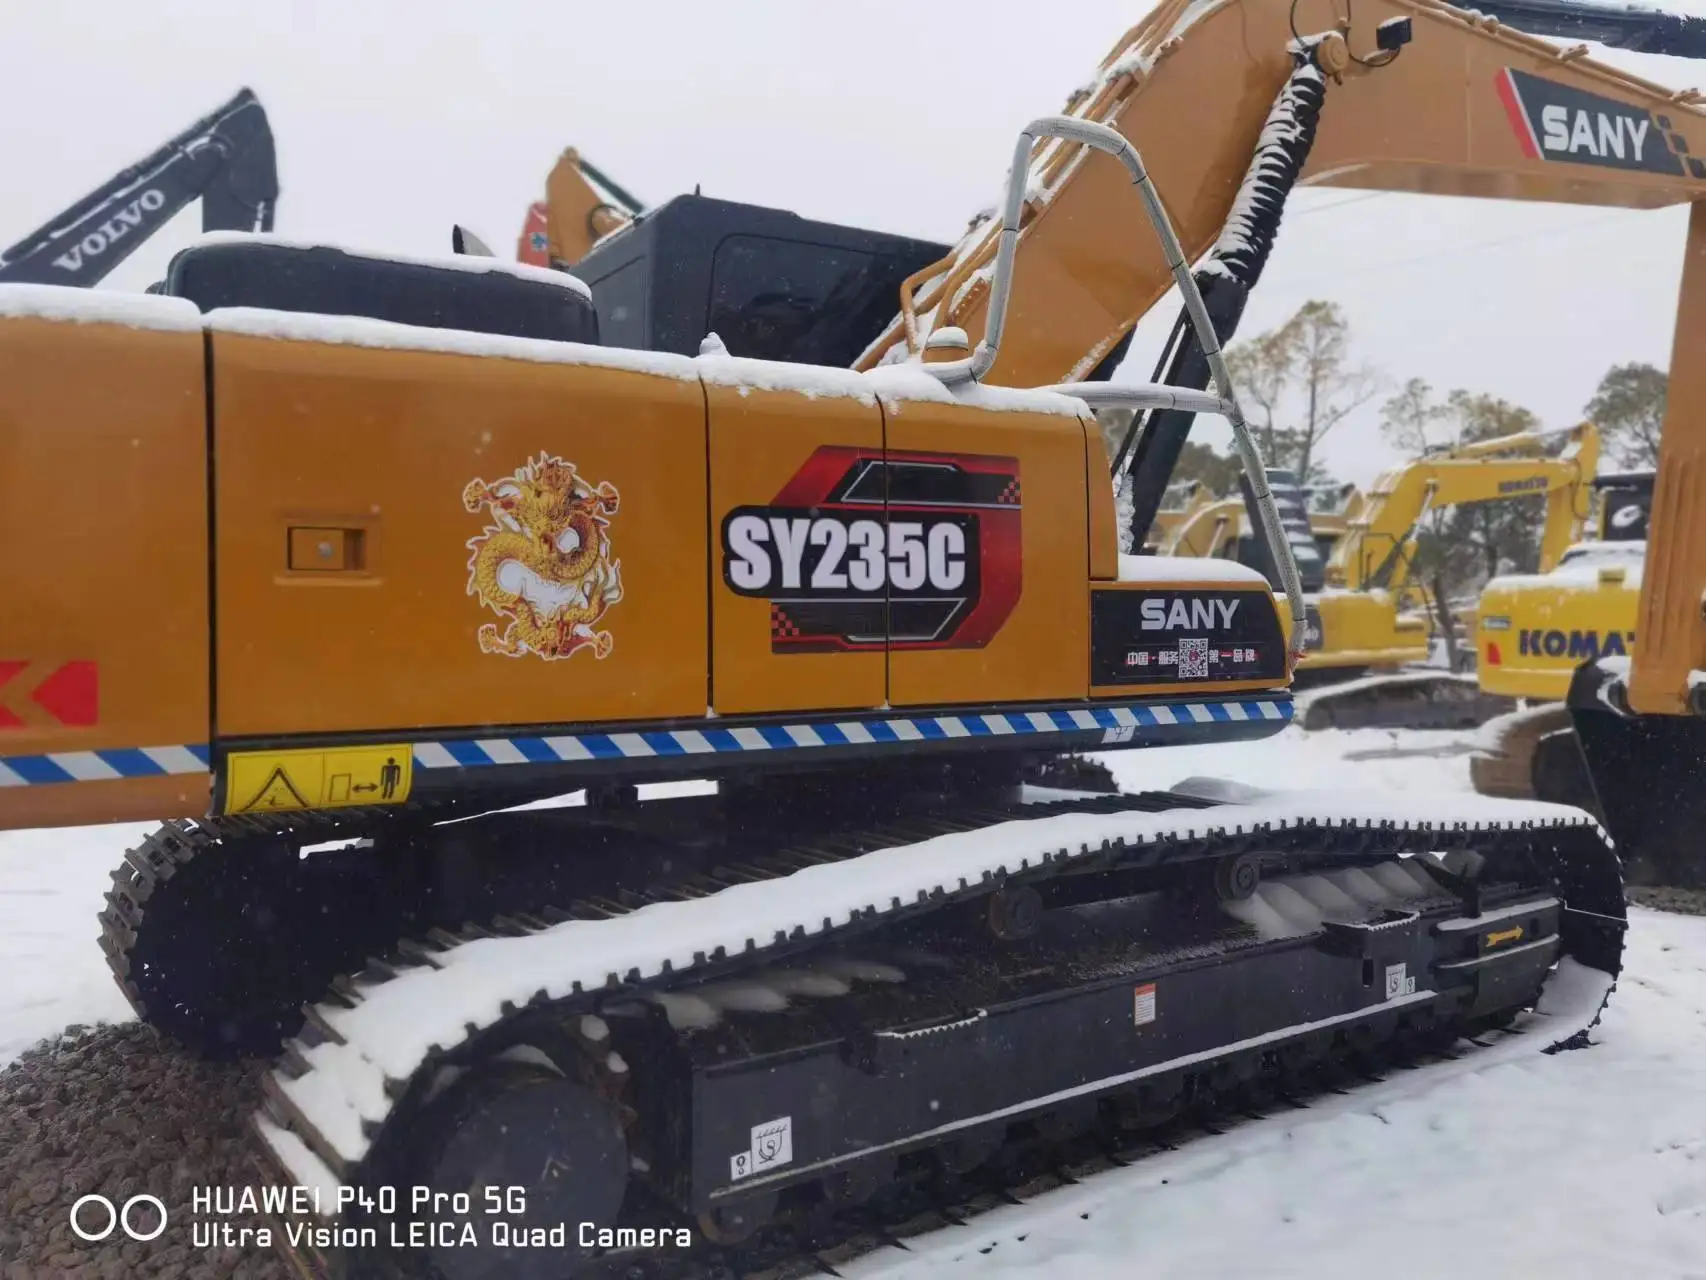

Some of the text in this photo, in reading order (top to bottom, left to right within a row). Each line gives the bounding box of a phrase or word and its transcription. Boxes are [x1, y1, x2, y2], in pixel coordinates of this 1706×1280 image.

[1542, 104, 1649, 161] SANY
[51, 189, 165, 271] VOLVO
[727, 515, 966, 591] SY235C
[1140, 599, 1240, 630] SANY
[1208, 648, 1257, 664] 第一品牌
[1519, 629, 1636, 657] KOMA
